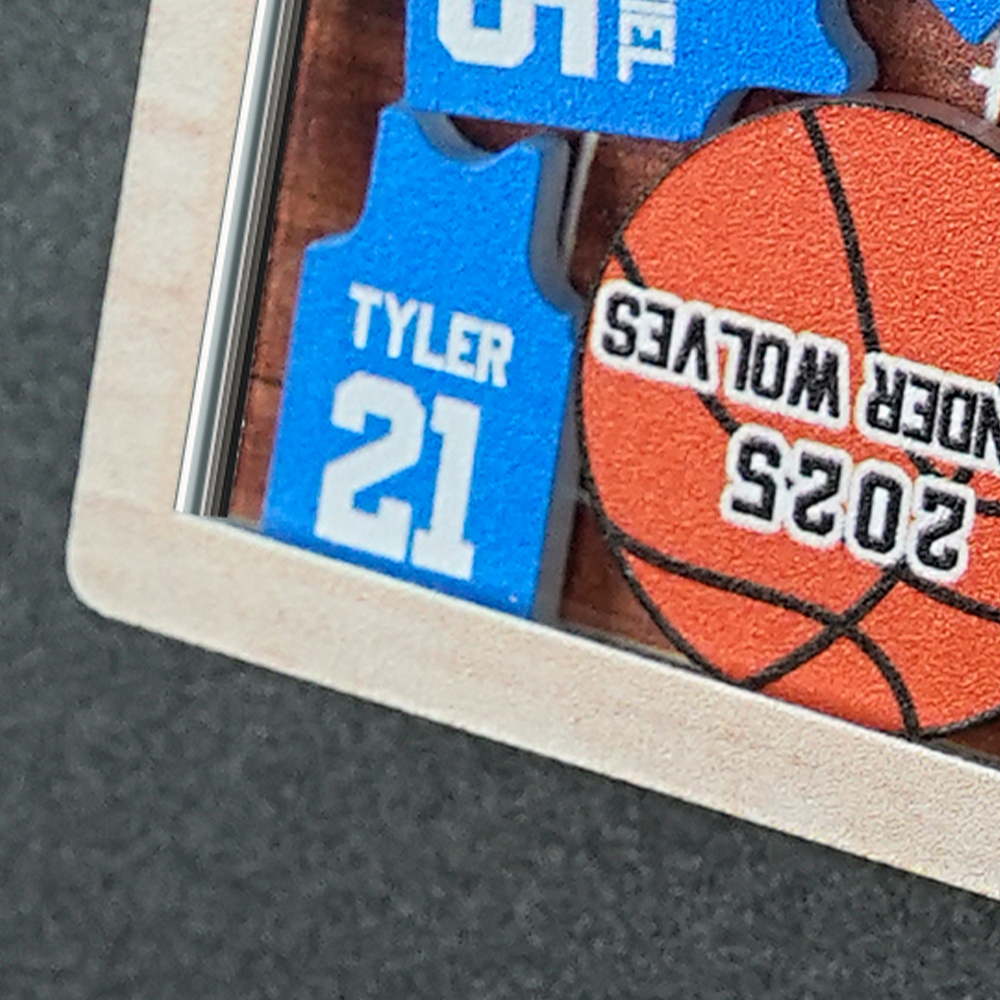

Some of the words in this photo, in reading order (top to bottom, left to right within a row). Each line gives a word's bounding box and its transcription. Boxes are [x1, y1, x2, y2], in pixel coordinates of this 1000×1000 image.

[349, 285, 512, 386] TYLER
[594, 283, 848, 427] WOLVES
[313, 373, 478, 577] 21
[723, 428, 975, 579] 2025
